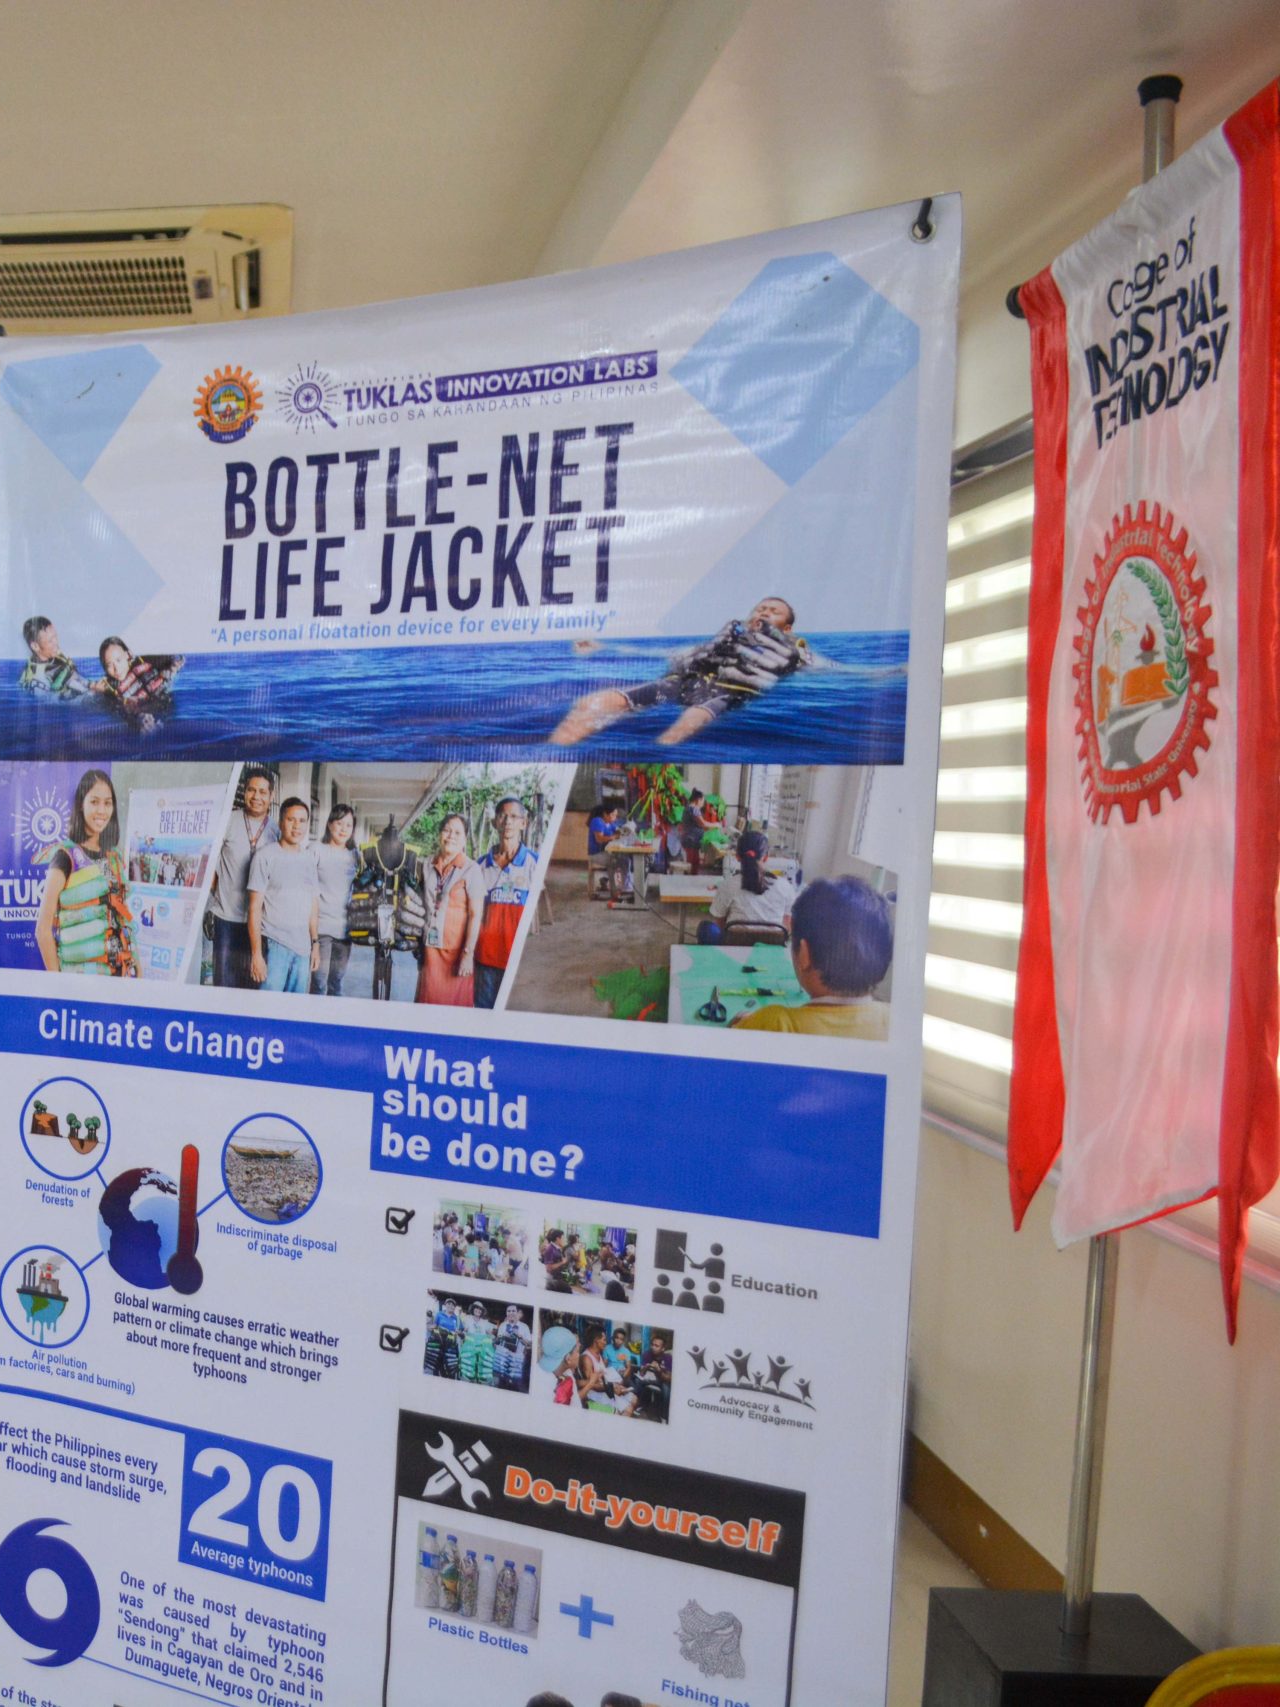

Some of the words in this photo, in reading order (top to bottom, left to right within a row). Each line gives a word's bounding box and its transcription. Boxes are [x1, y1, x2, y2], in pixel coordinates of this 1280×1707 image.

[1174, 216, 1196, 270] of
[343, 380, 433, 412] TUKLAS
[447, 364, 584, 398] INNOVATION
[594, 357, 649, 380] LABS
[346, 411, 399, 427] TUNGO
[407, 409, 425, 421] SA
[433, 397, 531, 418] KAHANDAAN
[540, 393, 562, 406] NG
[573, 382, 658, 400] PILIPINAS
[224, 422, 634, 540] BOTTLE-NET
[218, 537, 346, 621] LIFE
[370, 516, 626, 615] JACKET
[232, 624, 304, 646] personal
[309, 622, 391, 640] floatation
[397, 618, 453, 637] device
[459, 616, 484, 633] for
[490, 616, 540, 635] every
[159, 822, 175, 834] LIFE
[178, 821, 209, 834] JACKET
[160, 809, 211, 823] BOTTLE-NET
[4, 910, 40, 918] INNOV
[38, 1008, 152, 1050] Climate
[164, 1020, 285, 1070] Change
[384, 1045, 494, 1091] What
[382, 1084, 528, 1131] should
[381, 1124, 431, 1162] be
[446, 1132, 584, 1181] done?
[25, 1179, 78, 1197] Denudation
[81, 1188, 91, 1198] of
[41, 1193, 74, 1207] forests
[216, 1222, 289, 1244] Indiscriminate
[292, 1234, 337, 1253] disposal
[247, 1240, 259, 1251] of
[260, 1243, 303, 1260] garbage
[731, 1274, 818, 1300] Education
[113, 1311, 152, 1329] pattern
[154, 1320, 166, 1331] or
[169, 1321, 212, 1340] climate
[214, 1330, 258, 1351] change
[260, 1340, 296, 1358] which
[299, 1346, 339, 1368] brings
[114, 1292, 149, 1309] Global
[152, 1301, 200, 1323] warming
[203, 1312, 244, 1329] causes
[247, 1320, 286, 1337] erratic
[290, 1328, 339, 1348] weather
[9, 1356, 54, 1376] factories,
[55, 1367, 76, 1379] cars
[77, 1371, 94, 1384] and
[97, 1375, 136, 1396] burning)
[32, 1350, 45, 1361] Air
[47, 1353, 88, 1370] pollution
[126, 1330, 158, 1347] about
[161, 1340, 190, 1354] more
[193, 1342, 241, 1365] frequent
[244, 1357, 267, 1370] and
[270, 1361, 322, 1382] stronger
[193, 1361, 247, 1384] typhoons
[687, 1399, 744, 1418] Community
[748, 1409, 814, 1431] Engagement
[719, 1395, 770, 1414] Advocacy
[773, 1405, 781, 1414] &
[11, 1443, 48, 1461] which
[51, 1452, 87, 1471] cause
[90, 1461, 125, 1481] storm
[129, 1473, 167, 1496] surge,
[32, 1428, 52, 1445] the
[55, 1433, 121, 1463] Philippines
[125, 1454, 158, 1475] every
[6, 1456, 56, 1483] flooding
[60, 1471, 82, 1487] and
[86, 1475, 141, 1503] landslide
[187, 1447, 321, 1561] 20
[504, 1464, 781, 1555] Do-it-yourself
[191, 1540, 245, 1569] Average
[248, 1556, 313, 1587] typhoons
[119, 1592, 144, 1609] was
[163, 1606, 210, 1629] caused
[230, 1622, 247, 1643] by
[268, 1634, 325, 1664] typhoon
[120, 1571, 145, 1590] One
[153, 1582, 167, 1597] of
[174, 1587, 195, 1605] the
[203, 1598, 237, 1618] most
[245, 1607, 326, 1647] devastating
[192, 1631, 218, 1652] that
[224, 1642, 278, 1669] claimed
[284, 1659, 324, 1683] 2,546
[429, 1616, 474, 1640] Plastic
[479, 1630, 528, 1655] Bottles
[117, 1625, 146, 1647] lives
[151, 1635, 163, 1652] in
[167, 1641, 223, 1672] Cagayan
[229, 1661, 245, 1678] de
[250, 1667, 274, 1687] Oro
[280, 1679, 305, 1697] and
[310, 1684, 323, 1702] in
[125, 1646, 201, 1687] Dumaguete,
[205, 1672, 253, 1700] Negros
[1, 1686, 15, 1699] of
[18, 1690, 37, 1707] the
[661, 1679, 719, 1707] Fishing
